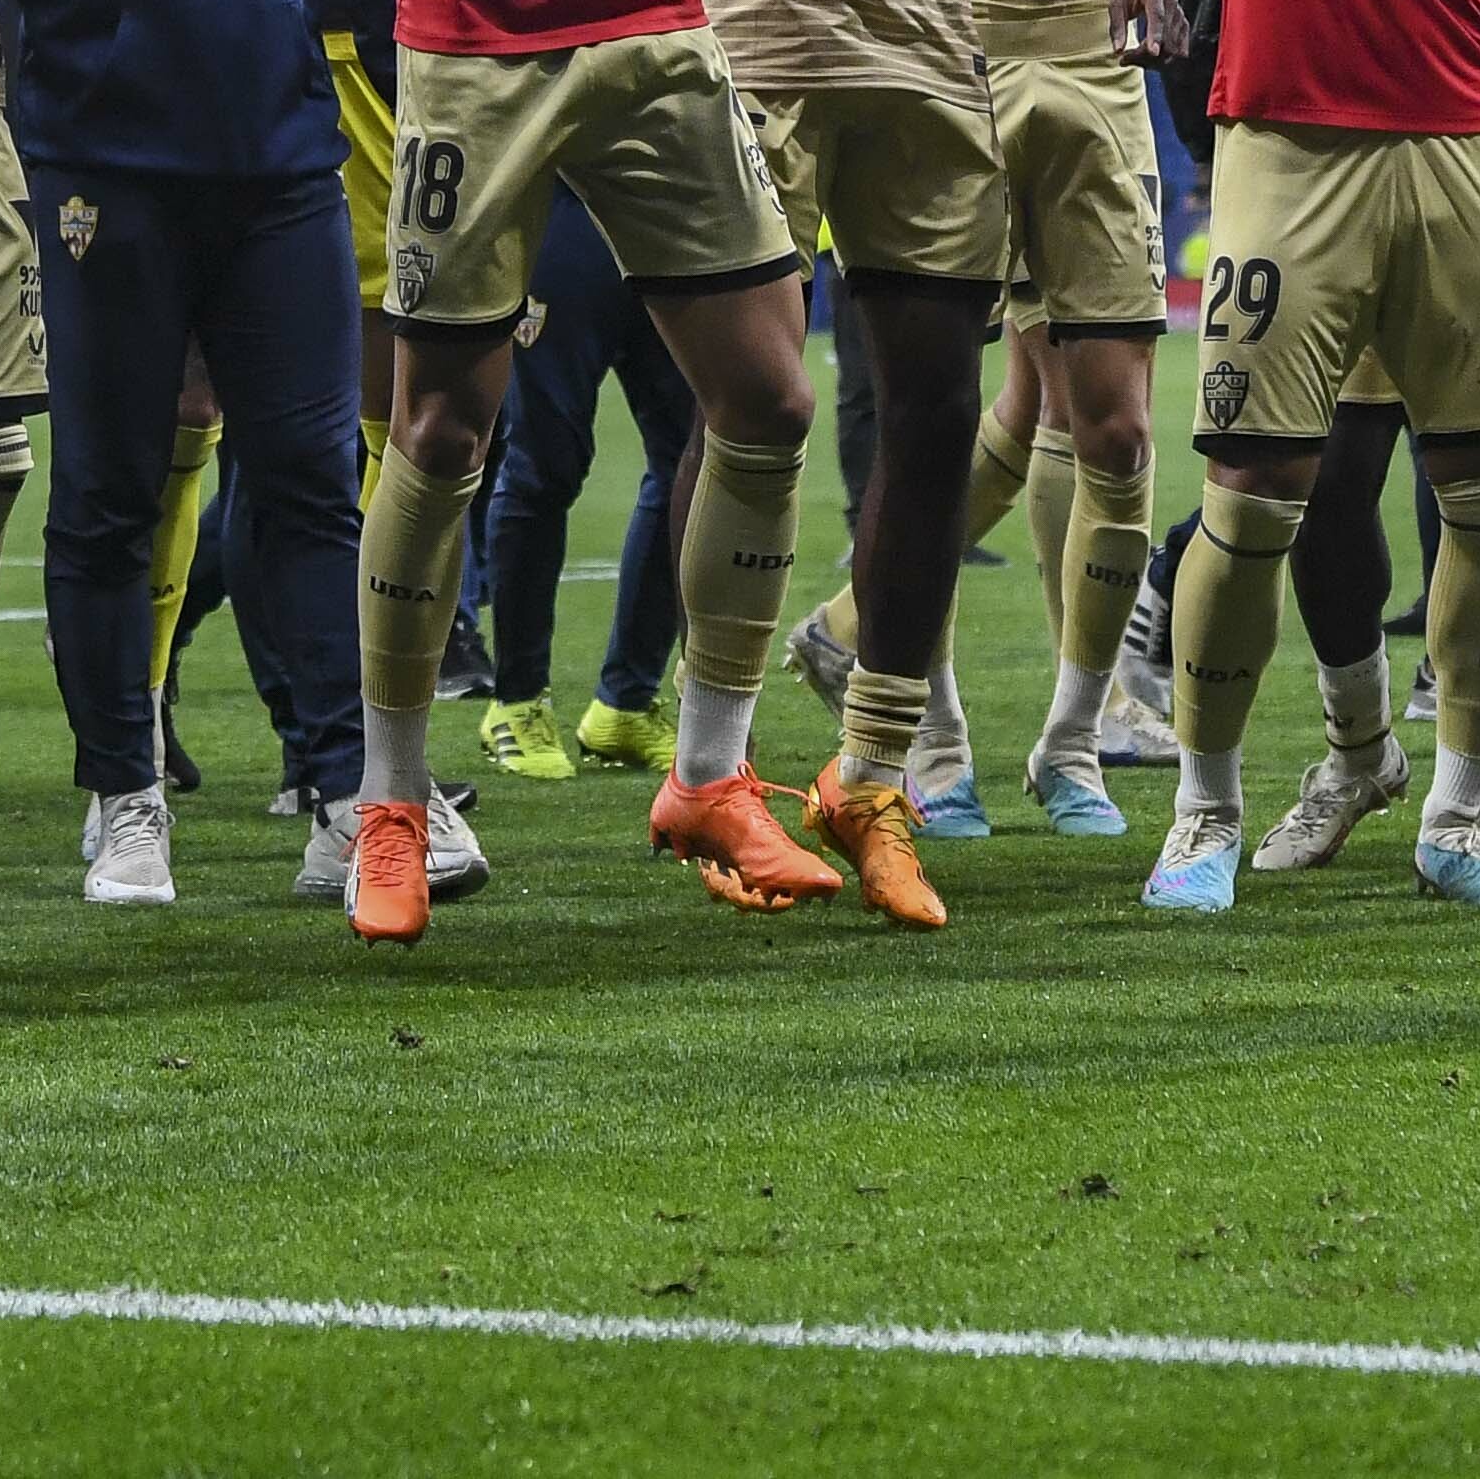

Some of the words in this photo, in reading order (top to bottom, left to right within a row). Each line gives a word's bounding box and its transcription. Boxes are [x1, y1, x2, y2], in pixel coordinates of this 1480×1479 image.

[399, 136, 465, 235] 18
[1203, 255, 1282, 345] 29
[1207, 375, 1217, 387] U
[734, 551, 794, 569] UDA
[370, 576, 435, 601] UDA
[1185, 659, 1251, 682] UDA
